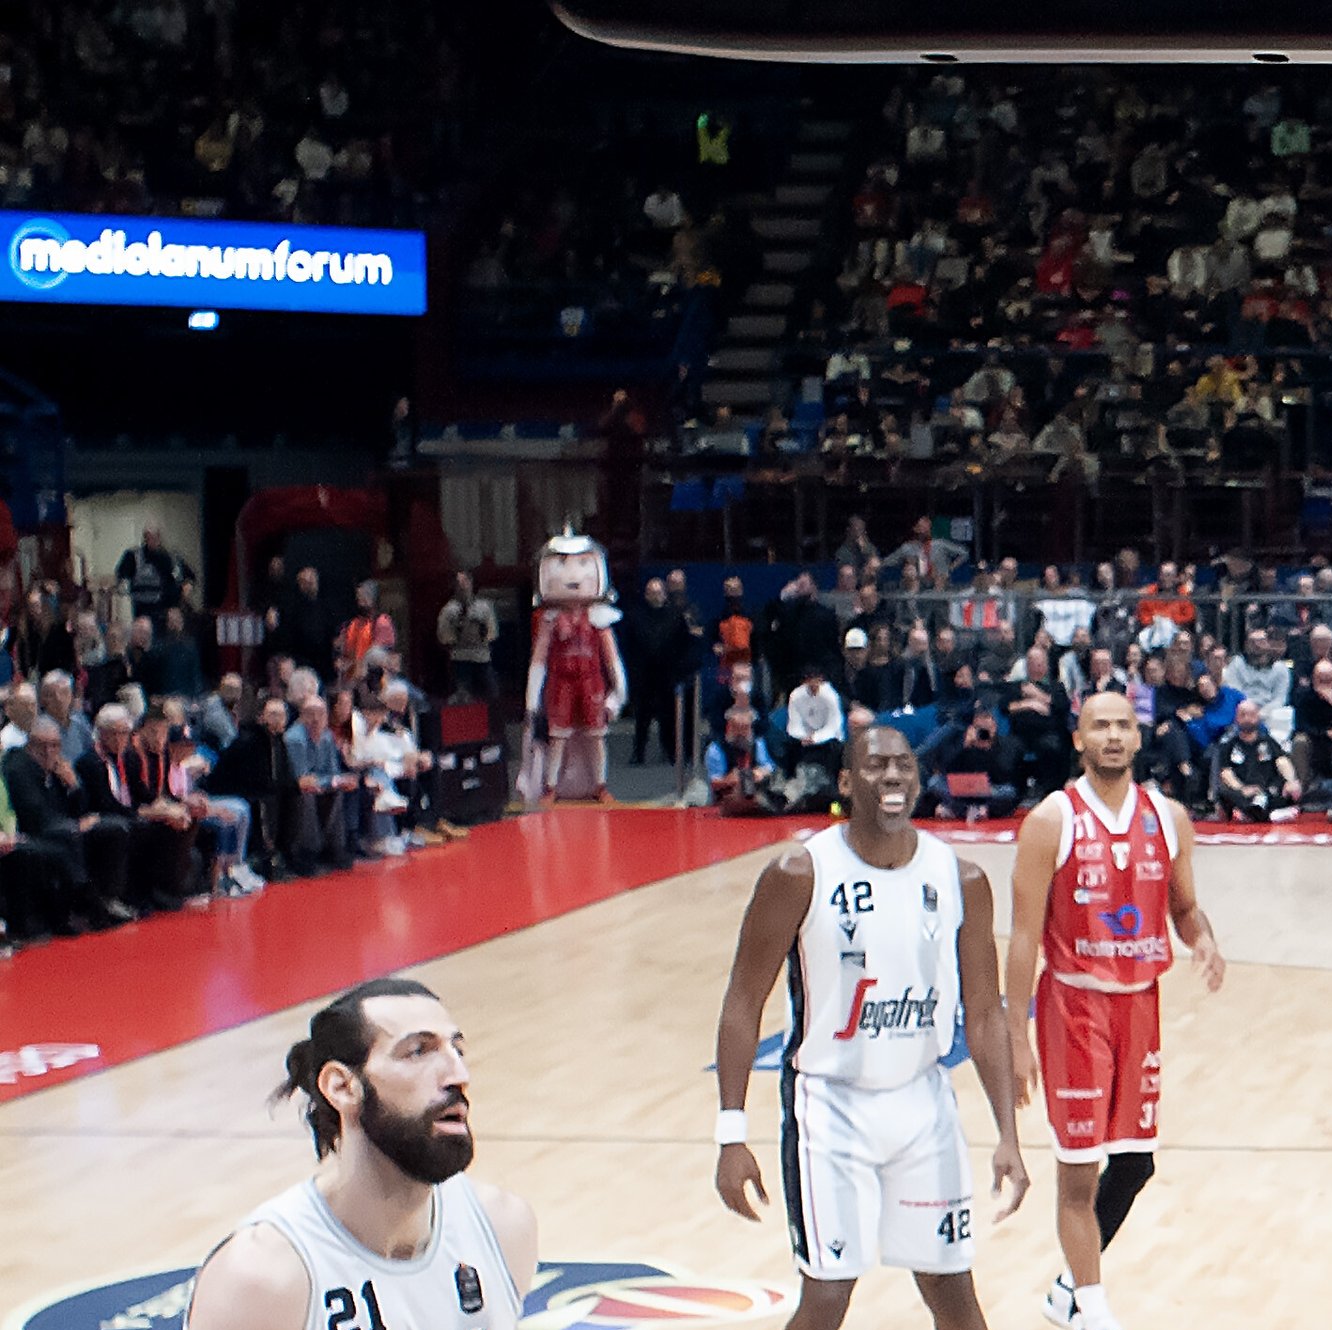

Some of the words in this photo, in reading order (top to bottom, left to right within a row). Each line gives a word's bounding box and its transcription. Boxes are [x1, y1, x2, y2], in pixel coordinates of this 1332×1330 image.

[19, 229, 393, 286] mediolanumforum
[829, 880, 875, 915] 42
[937, 1208, 972, 1245] 42
